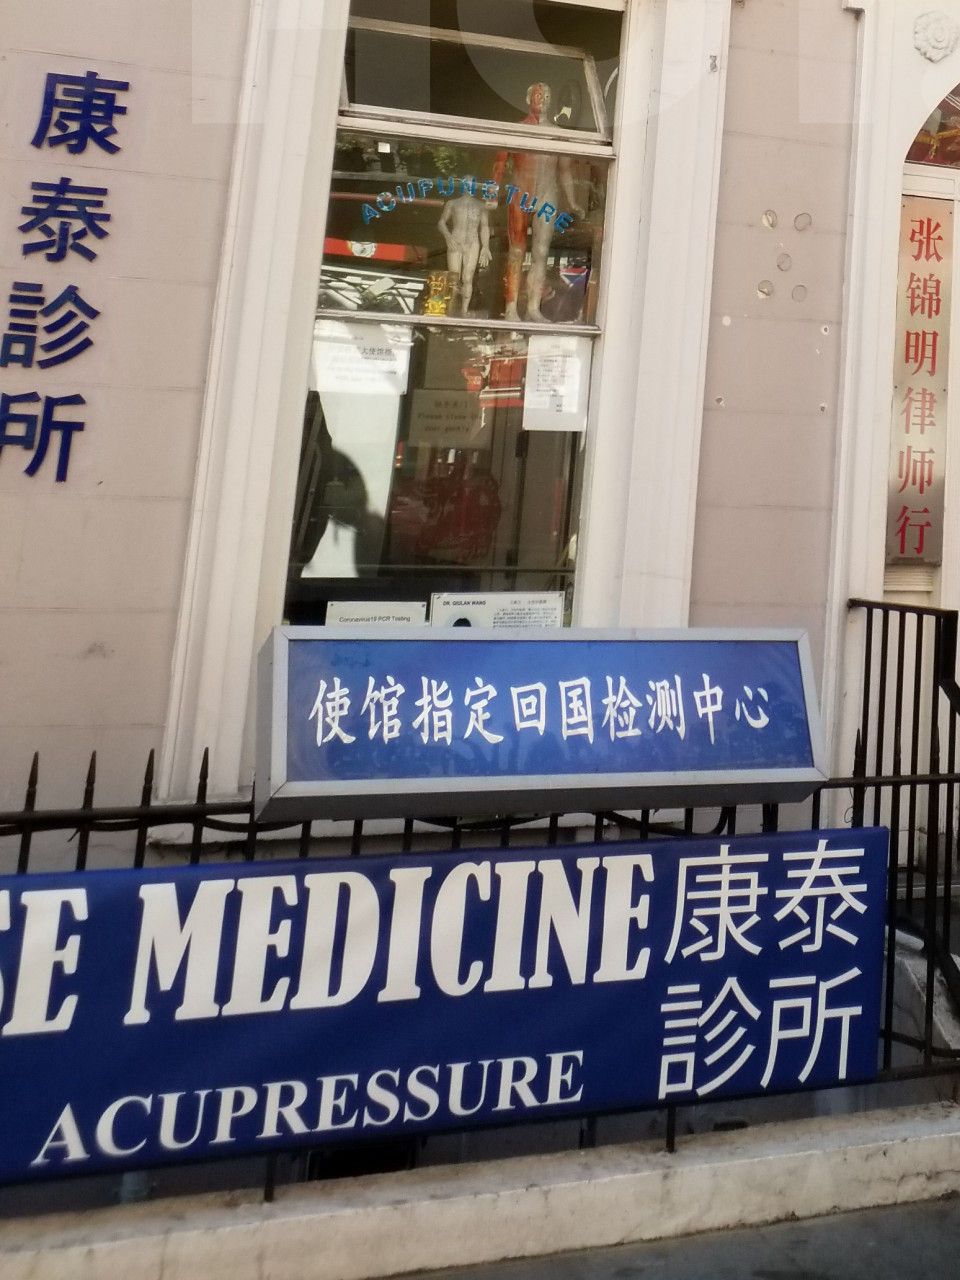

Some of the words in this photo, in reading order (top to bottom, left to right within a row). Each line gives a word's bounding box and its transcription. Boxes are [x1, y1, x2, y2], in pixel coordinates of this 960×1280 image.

[0, 70, 132, 485] 康泰診所
[360, 175, 577, 235] ACUPUNCTURE
[895, 217, 944, 555] 张锦明律师行
[308, 673, 771, 748] 使馆指定回国检测中心
[0, 887, 89, 1037] E
[123, 853, 655, 1026] MEDICINE
[30, 1049, 585, 1167] ACUPRESSURE
